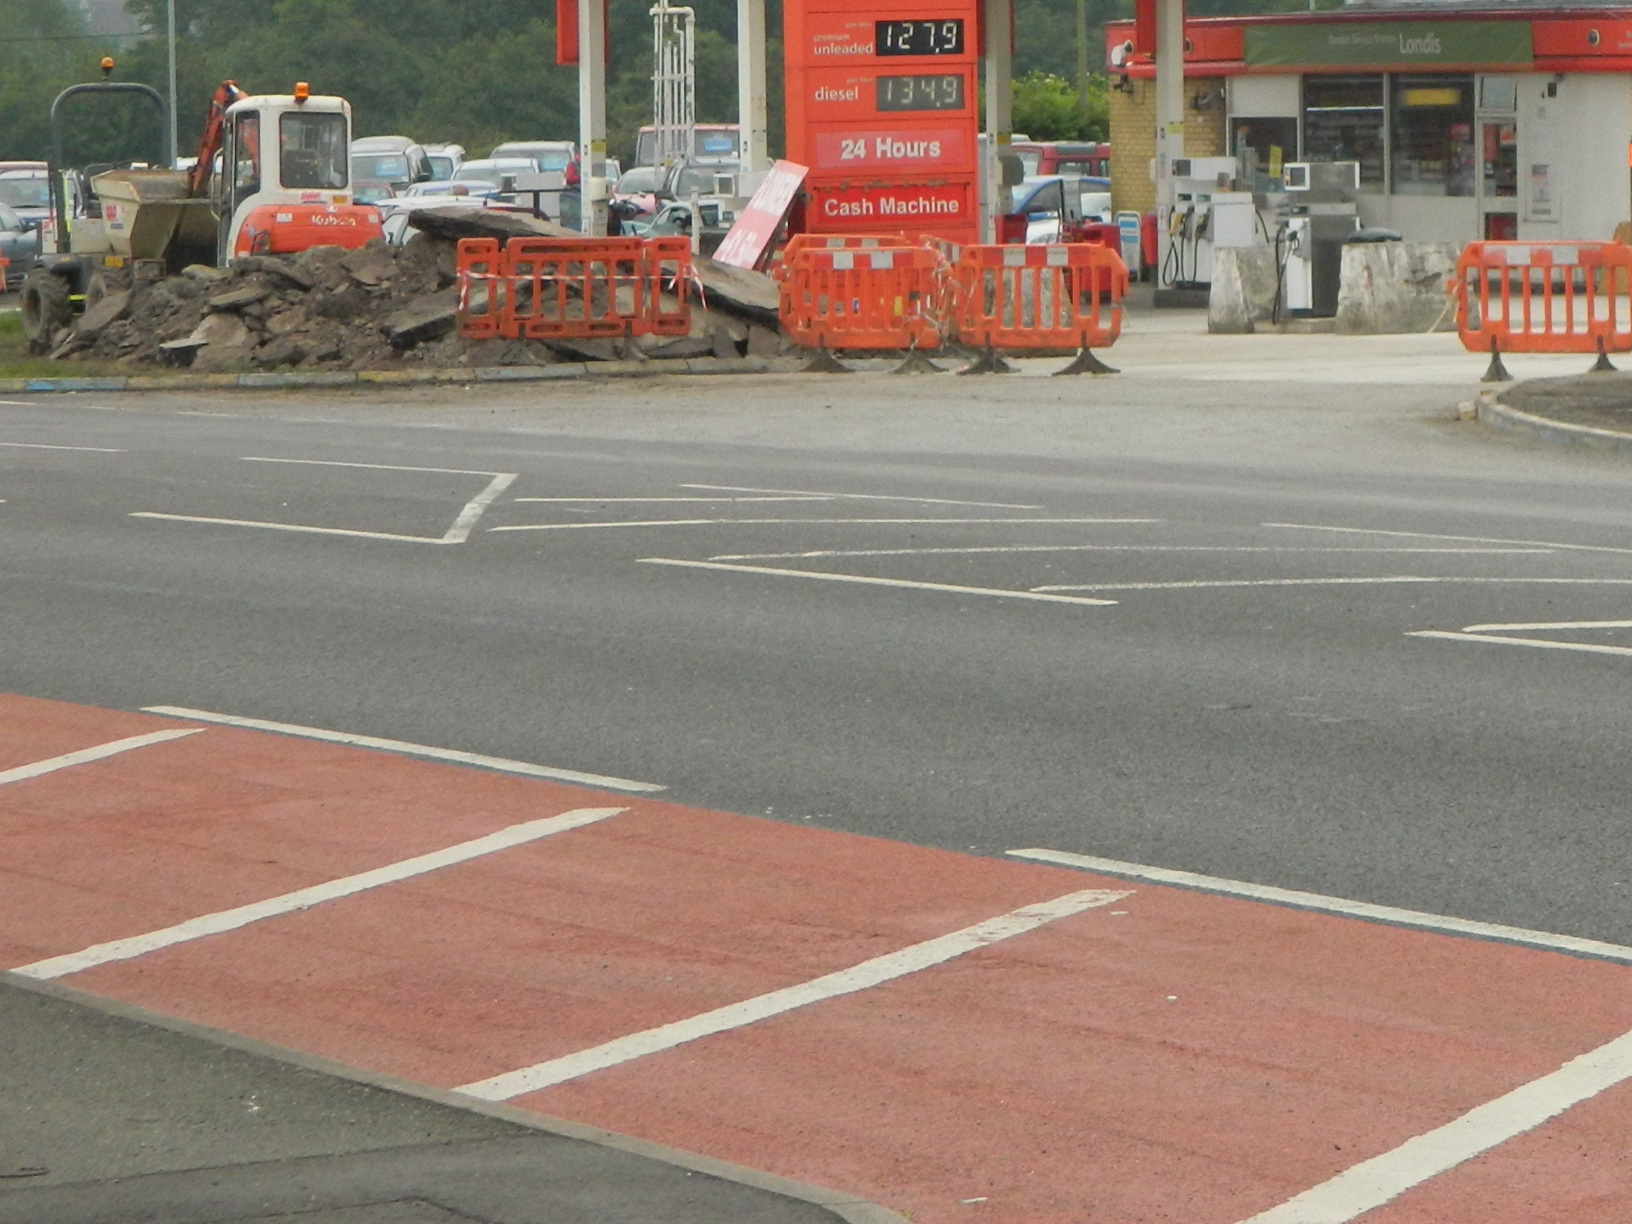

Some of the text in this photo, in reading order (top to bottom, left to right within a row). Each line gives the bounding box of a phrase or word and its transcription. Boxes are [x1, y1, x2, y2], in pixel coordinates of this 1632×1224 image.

[813, 42, 874, 56] unleaded
[1399, 33, 1441, 54] Londis
[814, 86, 859, 101] diesel
[840, 137, 941, 160] 24 Hours
[824, 196, 959, 216] Cash Machine
